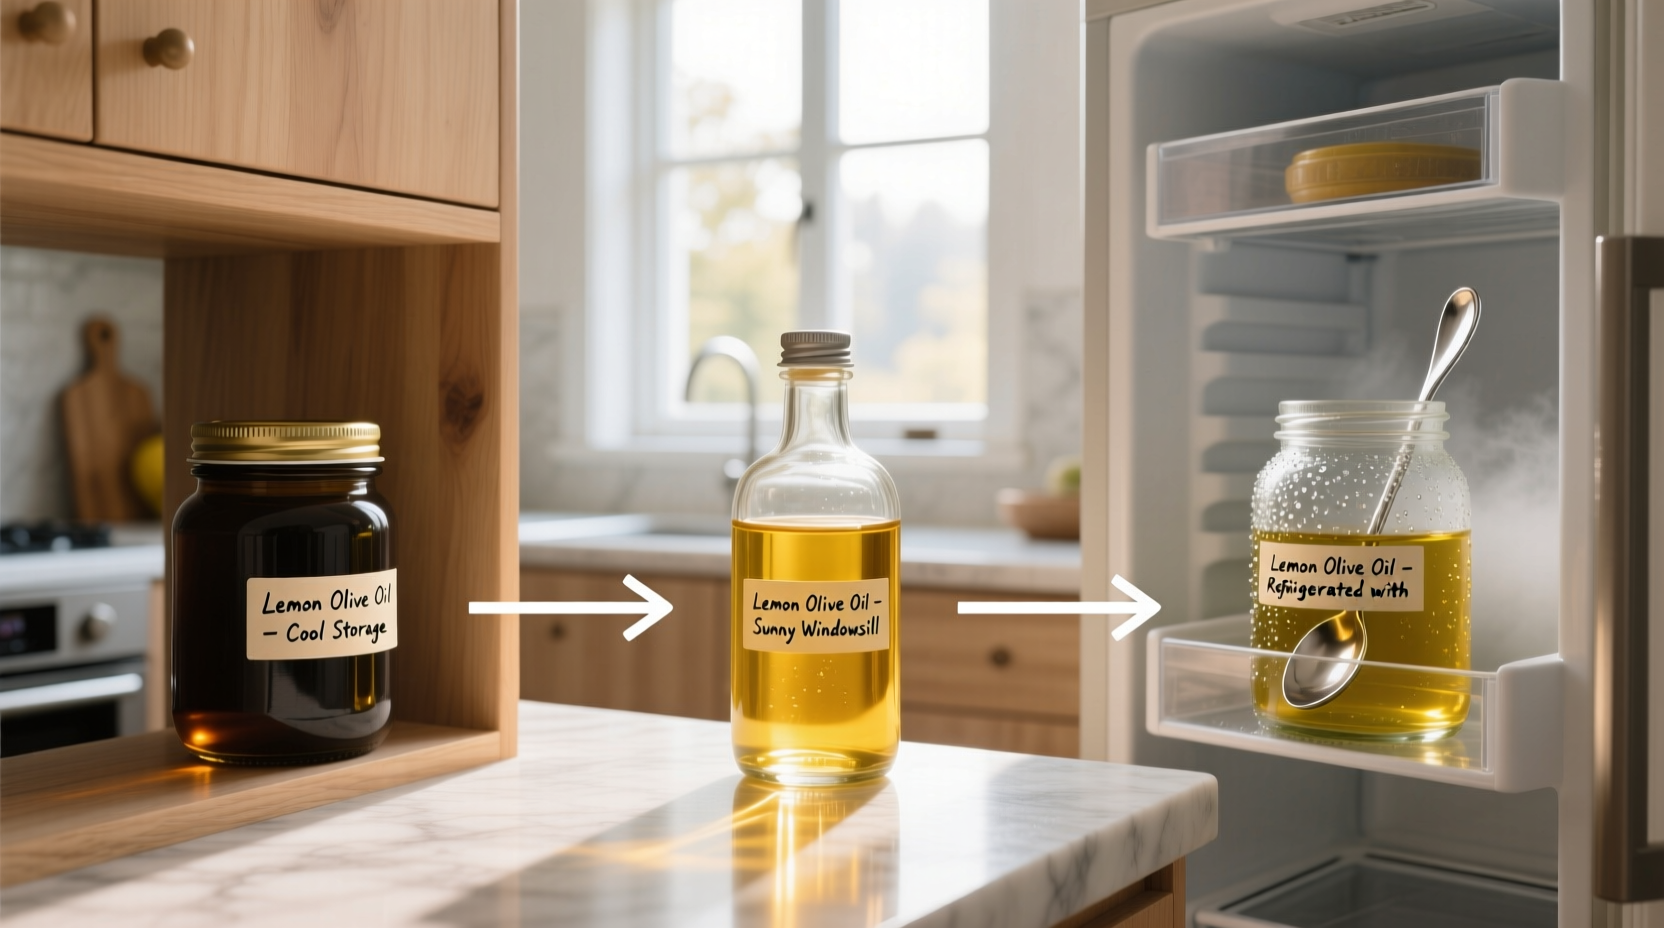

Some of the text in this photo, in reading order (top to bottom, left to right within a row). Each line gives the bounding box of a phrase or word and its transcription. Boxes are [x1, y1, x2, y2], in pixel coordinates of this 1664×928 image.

[1270, 554, 1318, 574] Lemon
[1323, 556, 1365, 576] Olive
[1371, 557, 1396, 576] Oil
[262, 582, 391, 615] Lemon Olive Oil
[1370, 580, 1409, 599] with
[752, 592, 800, 612] Lemon
[805, 594, 845, 612] Olive
[850, 592, 870, 611] Oil
[286, 619, 325, 642] Cool
[332, 619, 387, 644] Storage
[752, 615, 880, 645] Sunny Windowsill
